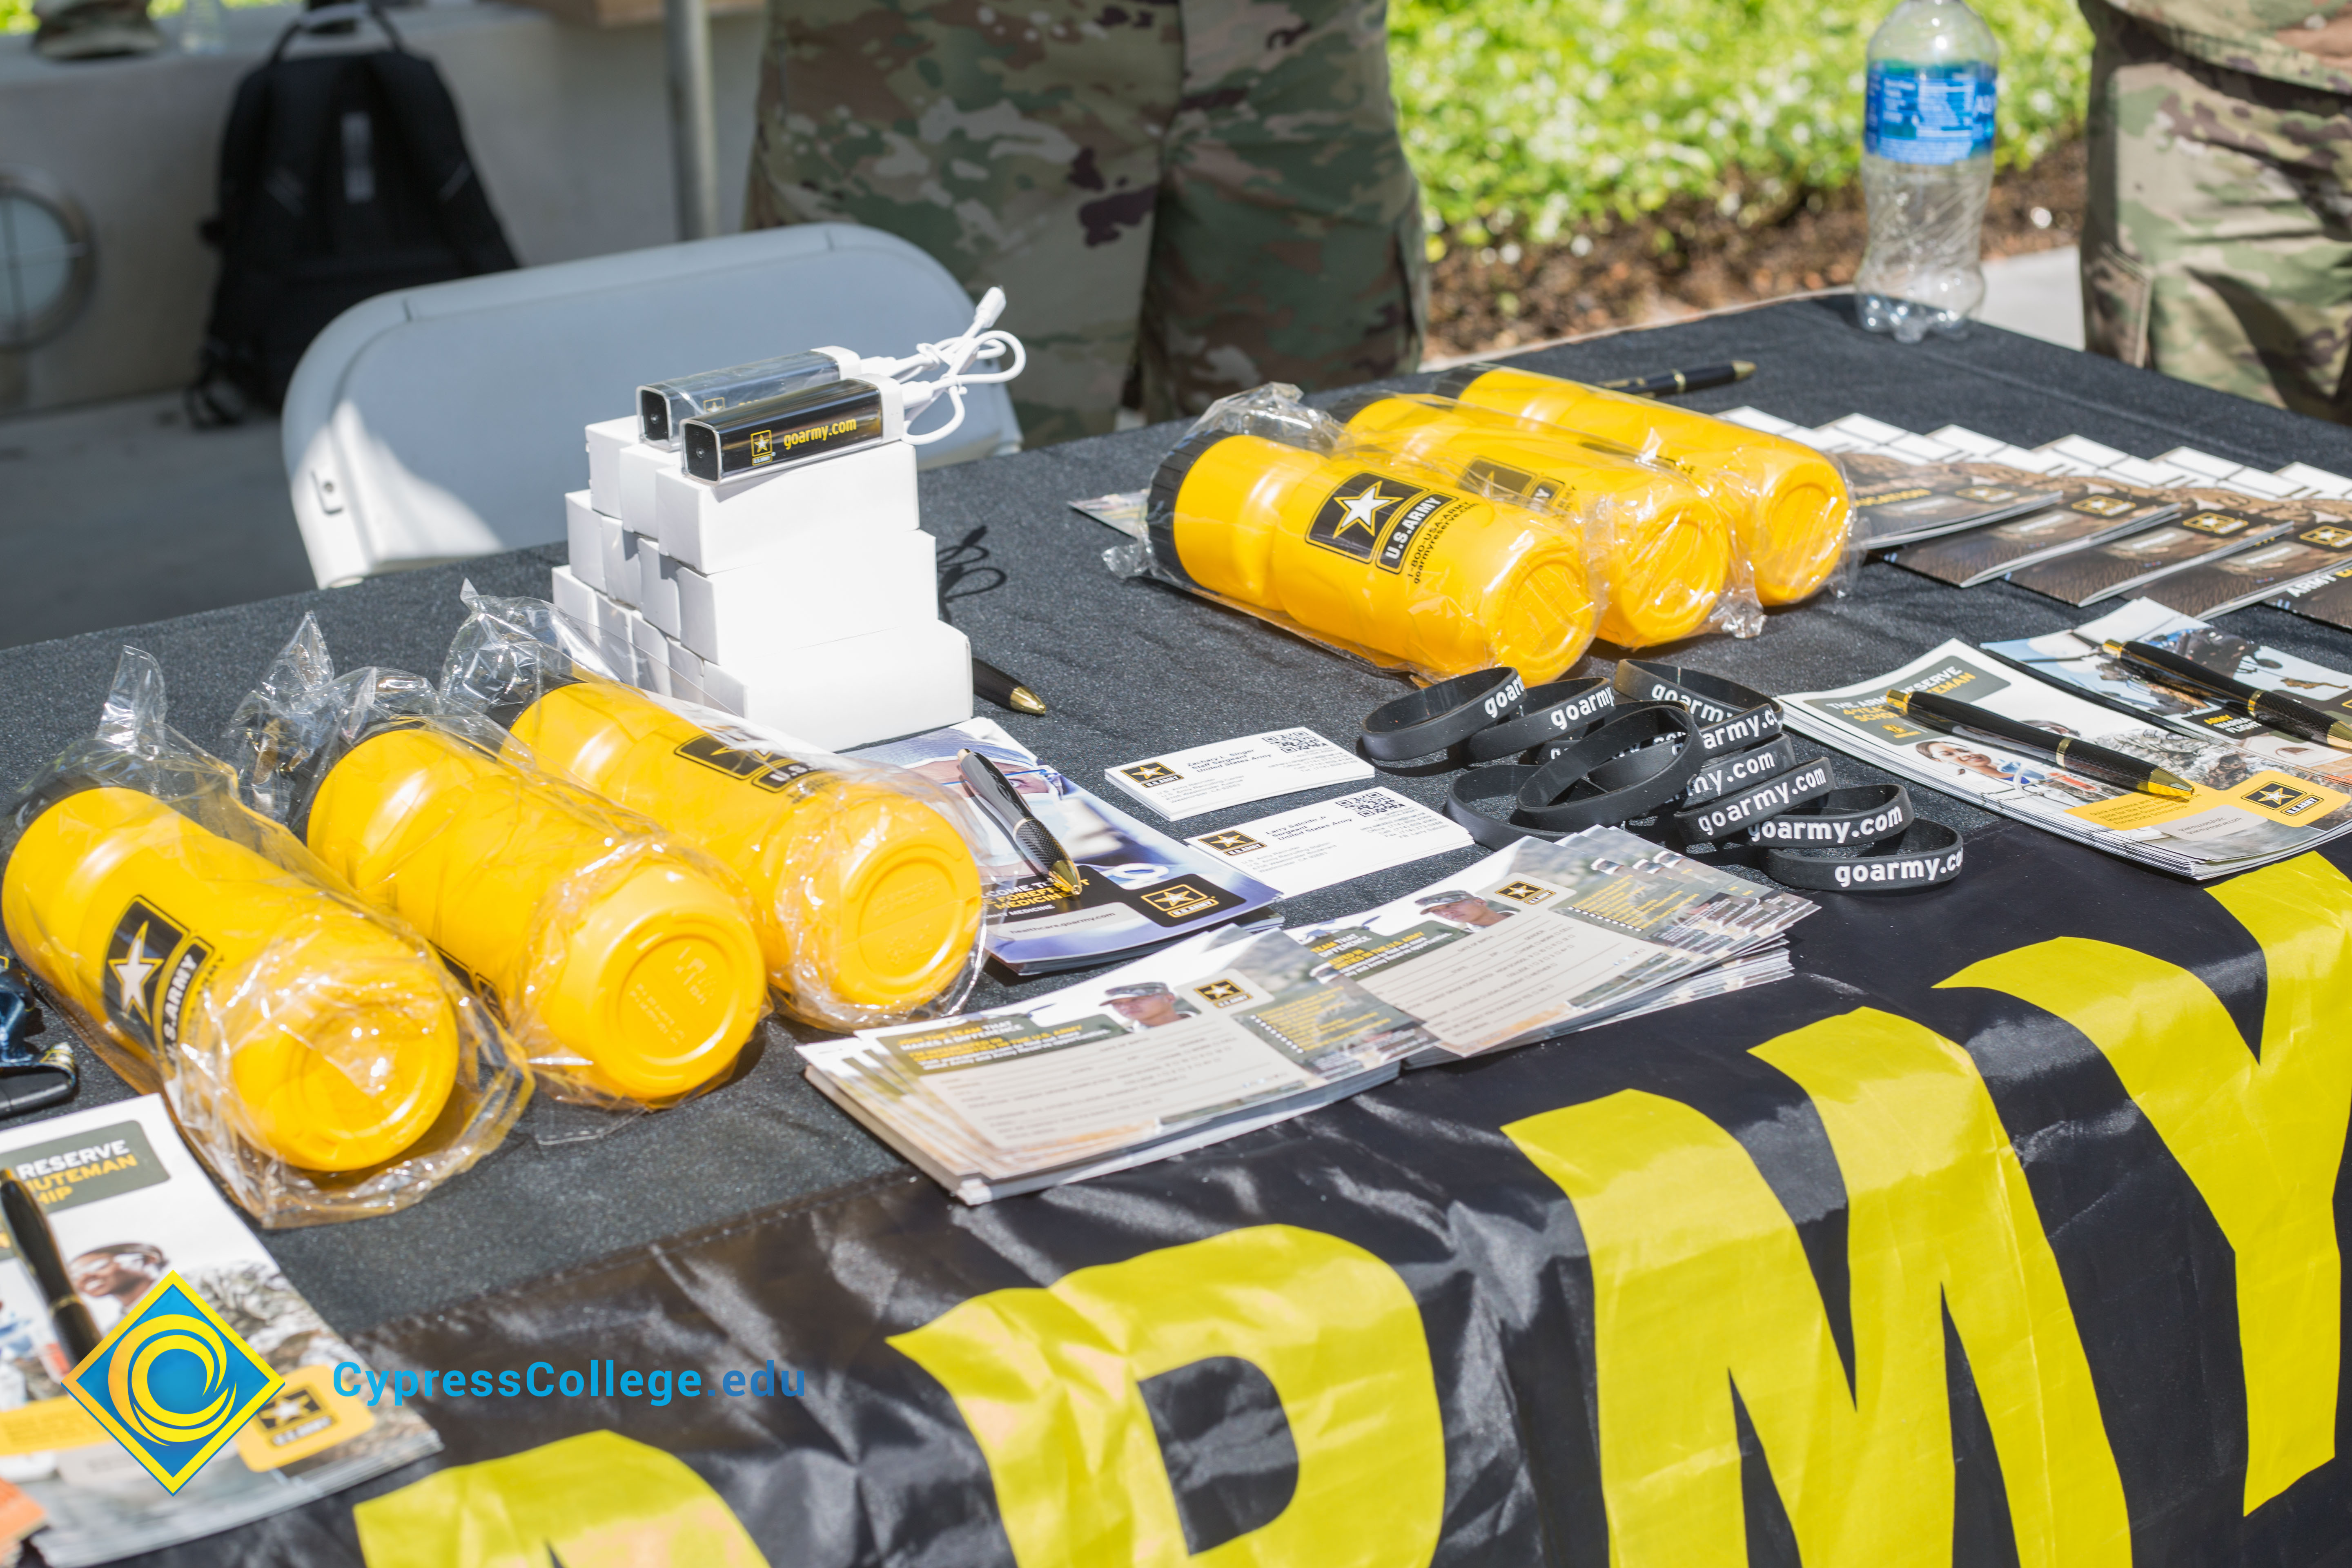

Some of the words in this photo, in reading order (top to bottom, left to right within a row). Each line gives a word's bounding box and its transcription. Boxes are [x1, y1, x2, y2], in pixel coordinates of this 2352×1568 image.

[784, 419, 857, 450] goarmy.com
[1385, 497, 1441, 559] U.S.ARMY
[1407, 501, 1470, 577] 1-800-USA-ARMY
[1414, 503, 1479, 584] goarmyreserve.com
[1858, 695, 1887, 707] ARM
[2204, 714, 2233, 725] ARMY
[2213, 718, 2252, 729] WARRA
[1146, 776, 1179, 787] U.S.ARMY
[1698, 768, 1826, 836] goarmy.com
[2286, 797, 2318, 815] U.S.ARMY
[1270, 826, 1310, 837] Sergeant
[1276, 831, 1306, 840] United
[1304, 824, 1333, 832] States
[1748, 806, 1903, 844] goarmy.com
[1227, 844, 1263, 855] U.S.ARMY
[1835, 847, 1963, 887] goarmy.co
[1009, 904, 1056, 916] MEDICINE
[1172, 901, 1214, 916] U.S.ARMY
[1010, 912, 1115, 935] healthcare.goarmy.com
[16, 1139, 130, 1180] RESERVE
